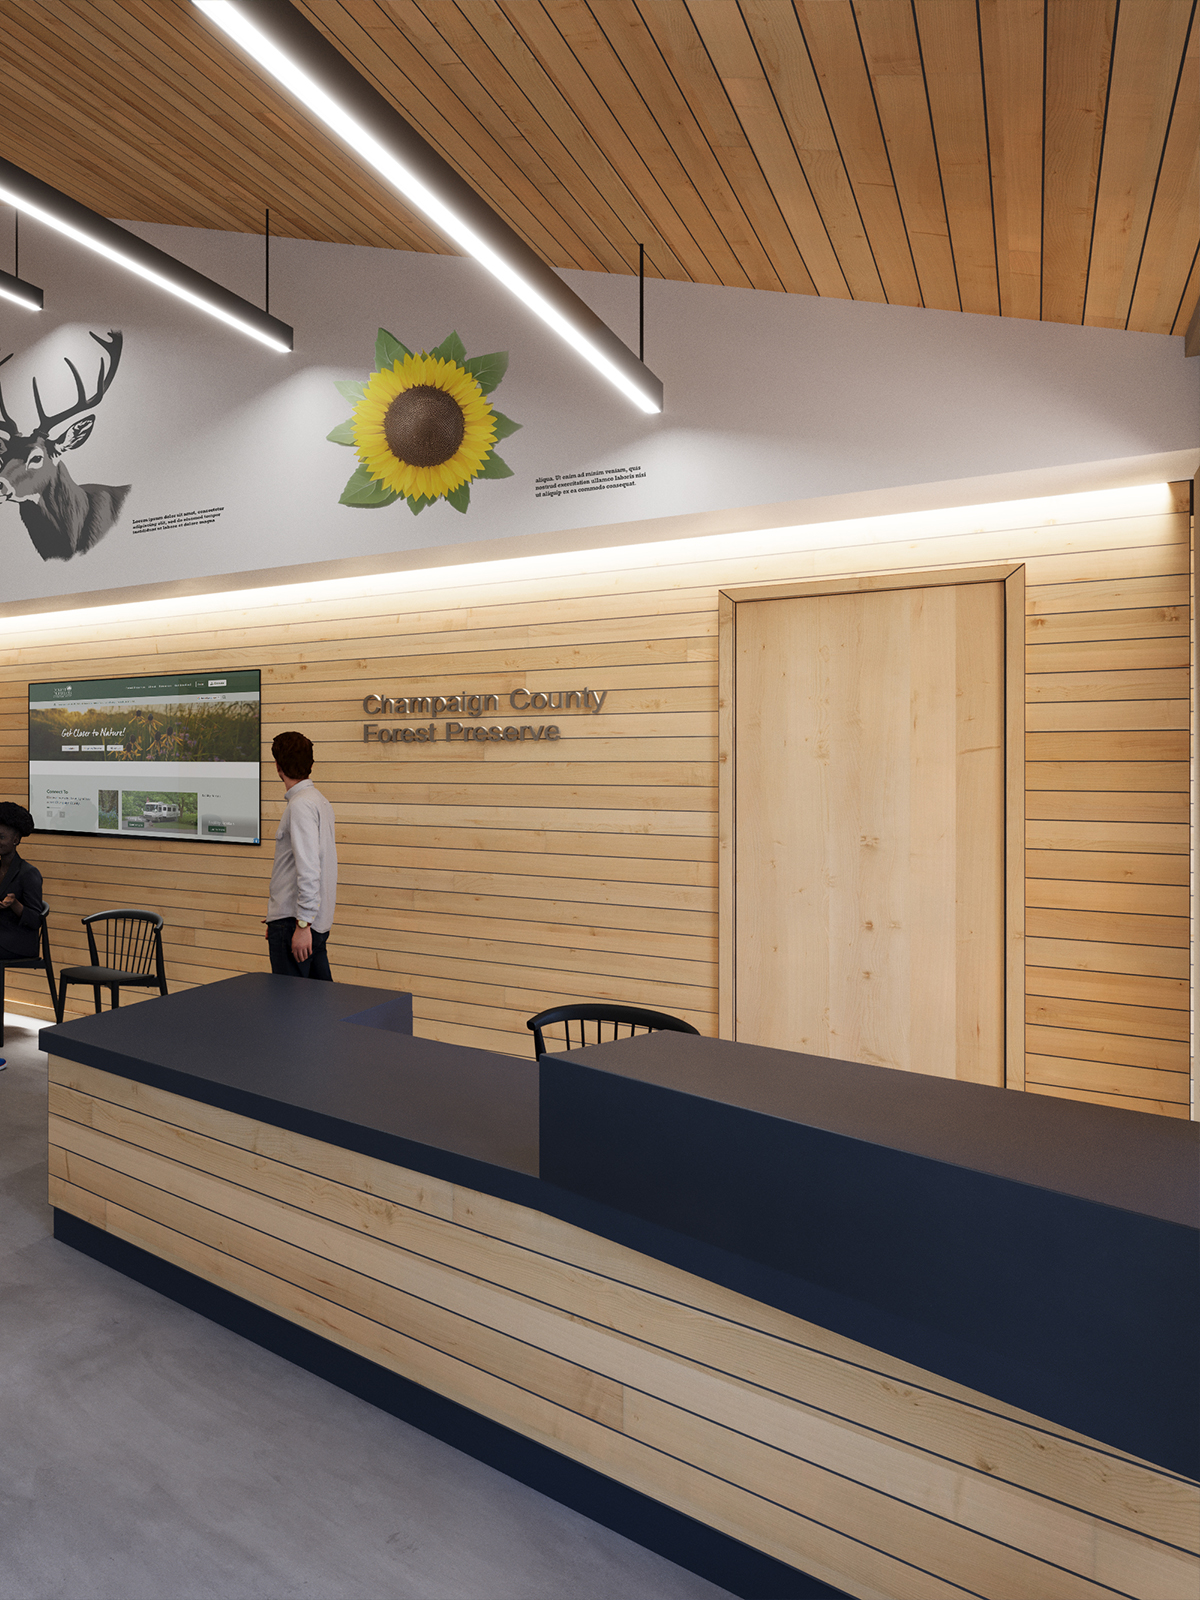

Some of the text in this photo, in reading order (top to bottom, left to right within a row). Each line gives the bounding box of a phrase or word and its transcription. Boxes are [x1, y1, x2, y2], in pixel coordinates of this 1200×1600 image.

[591, 476, 614, 484] ullamco
[578, 484, 605, 492] commodo
[362, 687, 608, 717] Champaign County
[61, 727, 127, 738] Get Closer to Nature!
[363, 721, 562, 743] Forest Preserve
